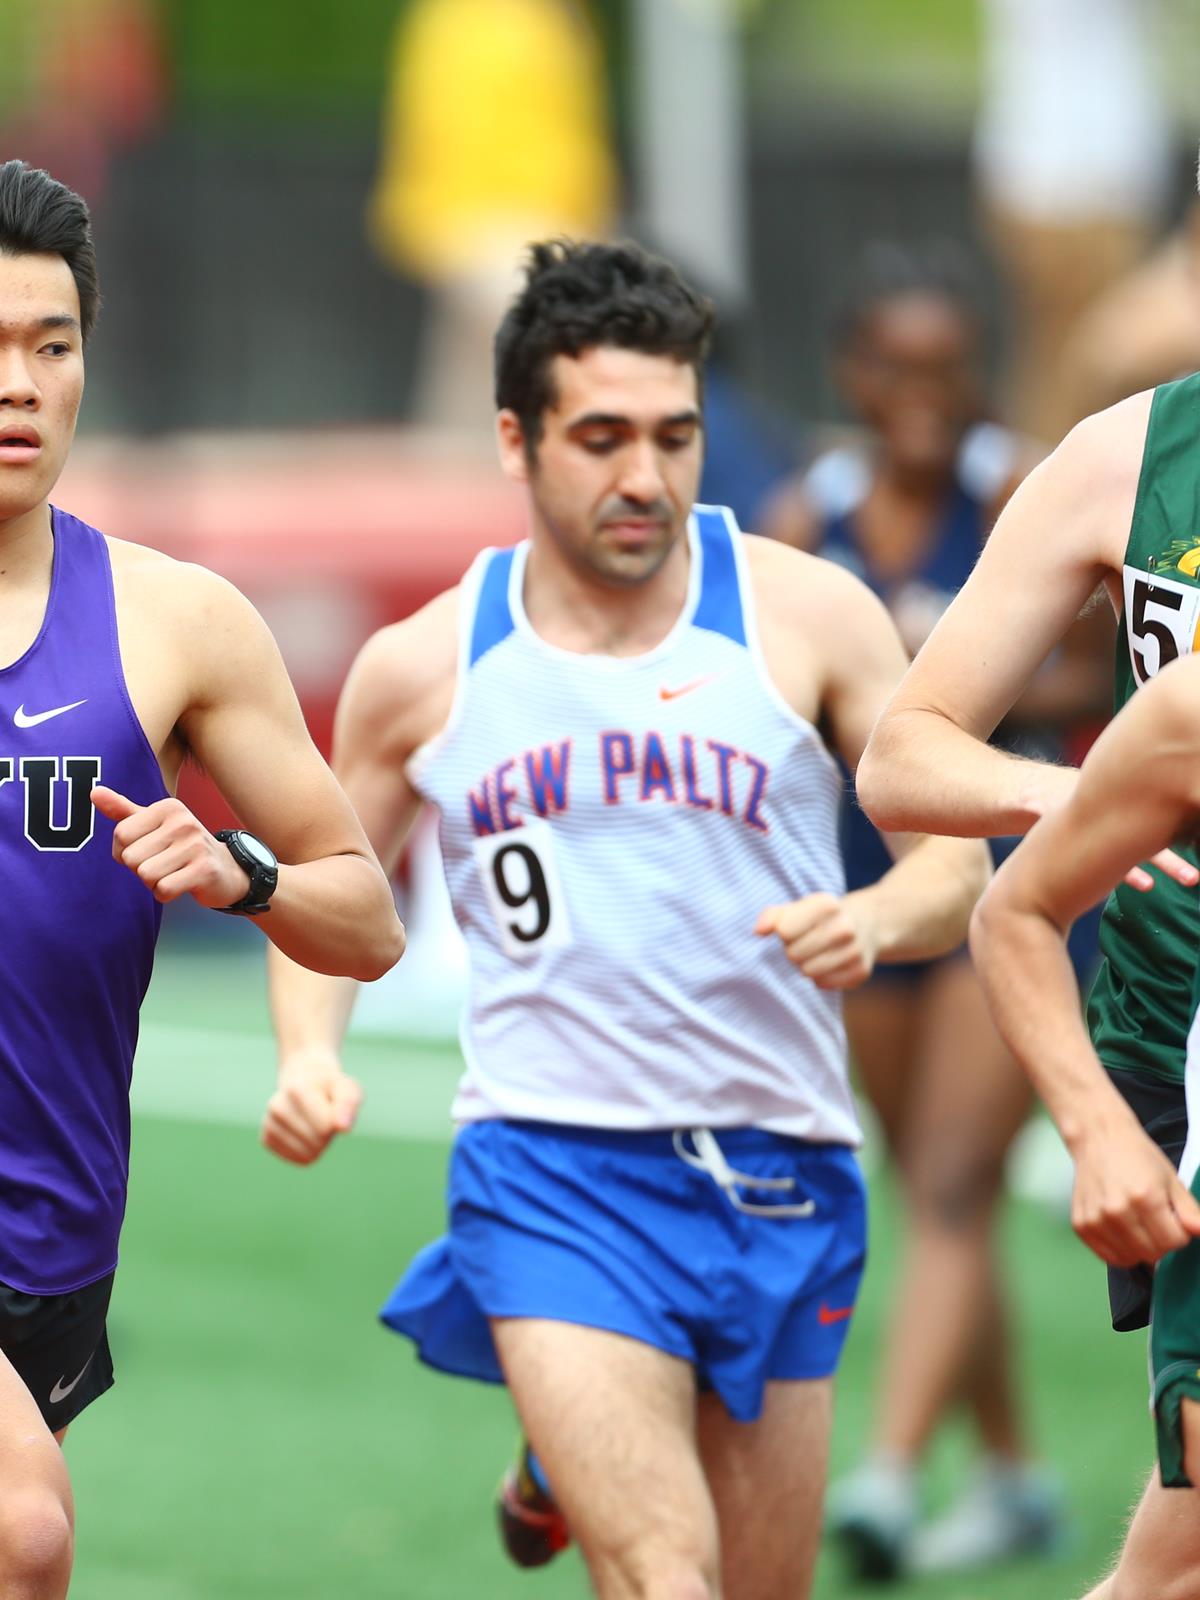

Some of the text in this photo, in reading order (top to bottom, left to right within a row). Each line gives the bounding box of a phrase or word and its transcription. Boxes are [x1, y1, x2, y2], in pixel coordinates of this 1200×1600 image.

[1132, 578, 1184, 684] 5
[467, 730, 769, 837] NEW PALTZ
[492, 842, 551, 943] 9
